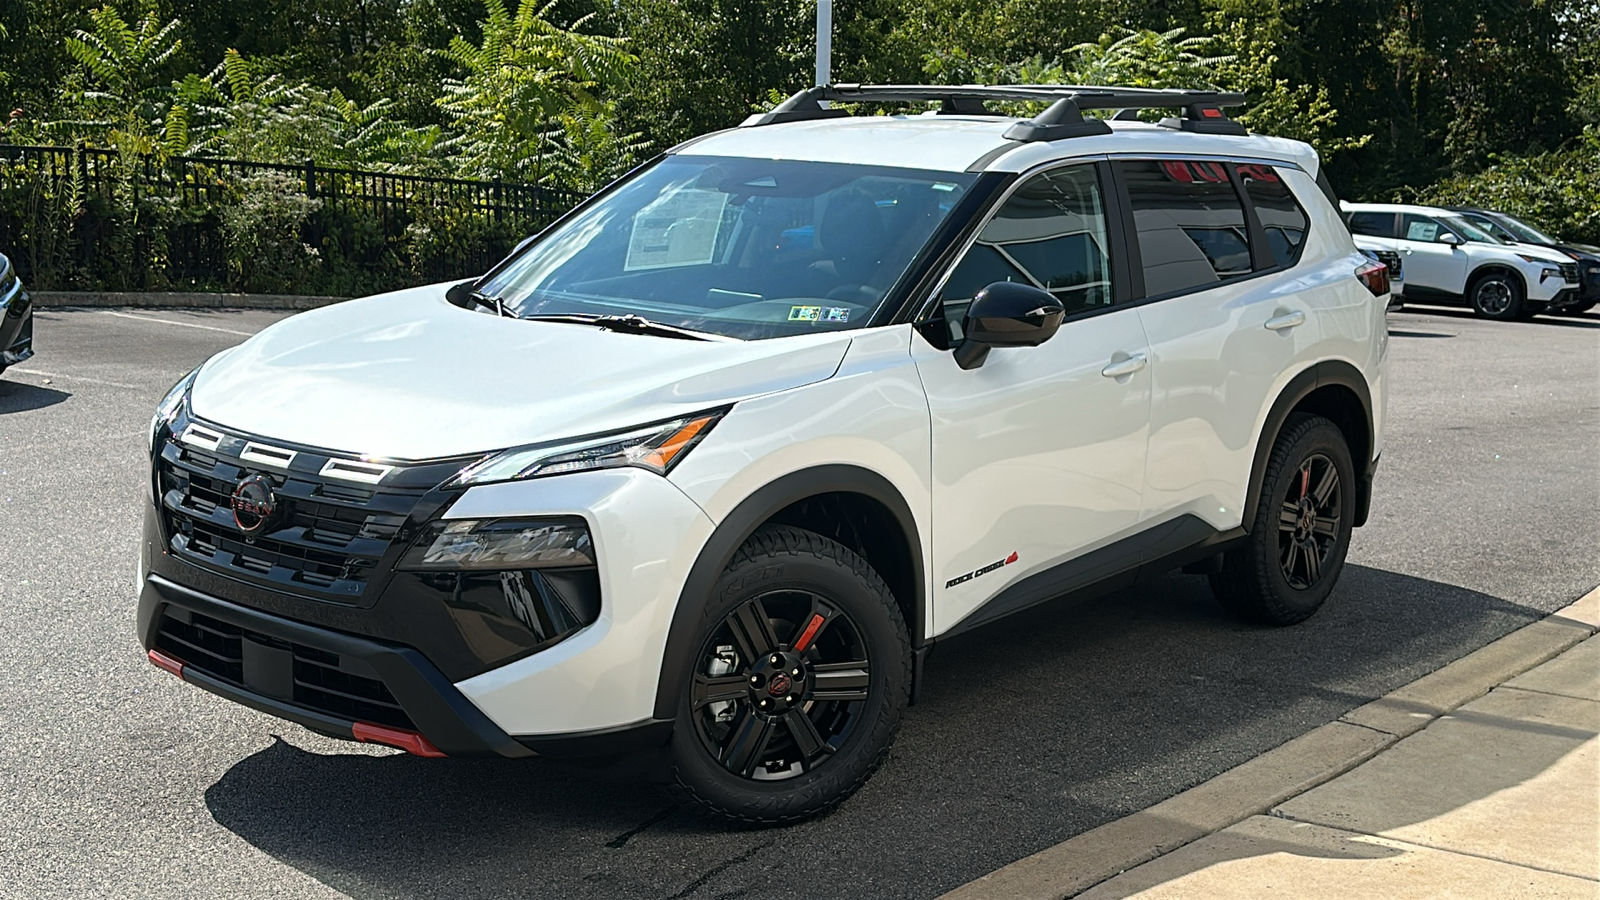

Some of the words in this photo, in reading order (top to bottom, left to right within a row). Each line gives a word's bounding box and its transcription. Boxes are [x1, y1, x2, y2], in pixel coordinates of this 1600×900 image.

[230, 497, 273, 516] NSSAN
[945, 571, 974, 589] ROCK
[975, 558, 1006, 578] CREEK
